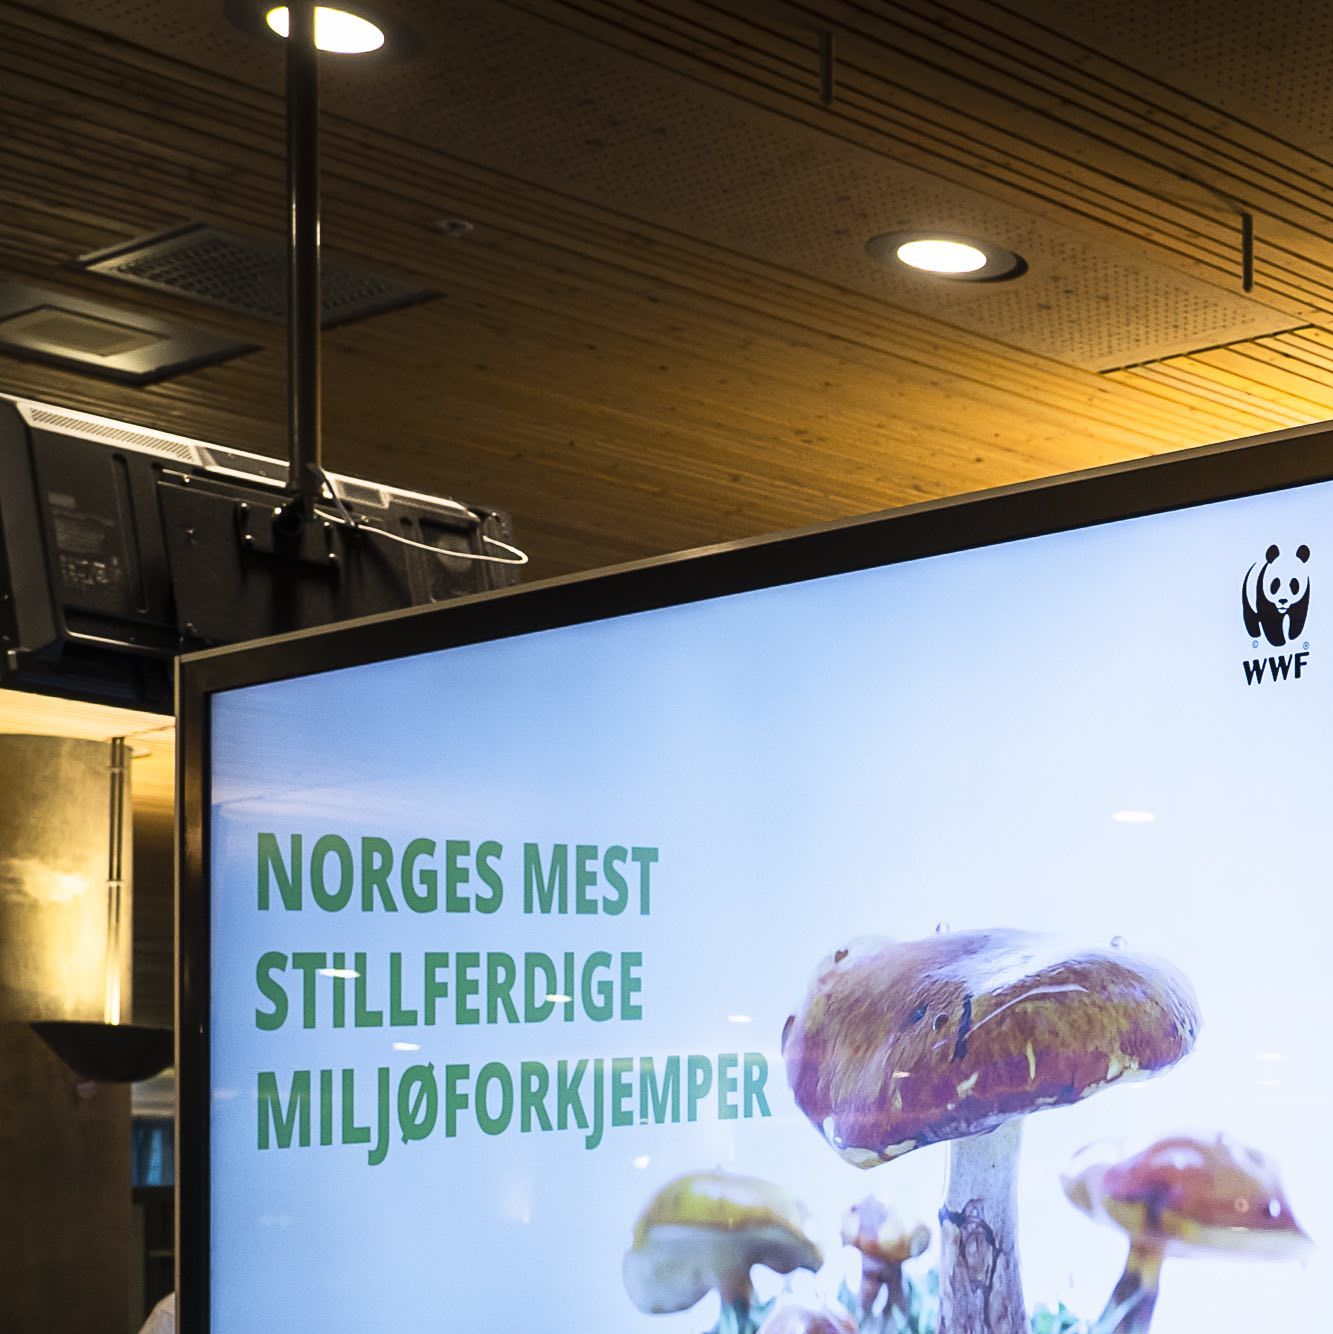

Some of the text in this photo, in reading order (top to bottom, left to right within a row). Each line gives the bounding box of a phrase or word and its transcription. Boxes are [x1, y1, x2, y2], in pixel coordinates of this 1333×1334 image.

[1243, 651, 1310, 686] WWF
[256, 831, 659, 916] NORGES MEST
[254, 950, 644, 1032] STILLFERDIGE
[256, 1052, 773, 1167] MILJØFORKJEMPER
